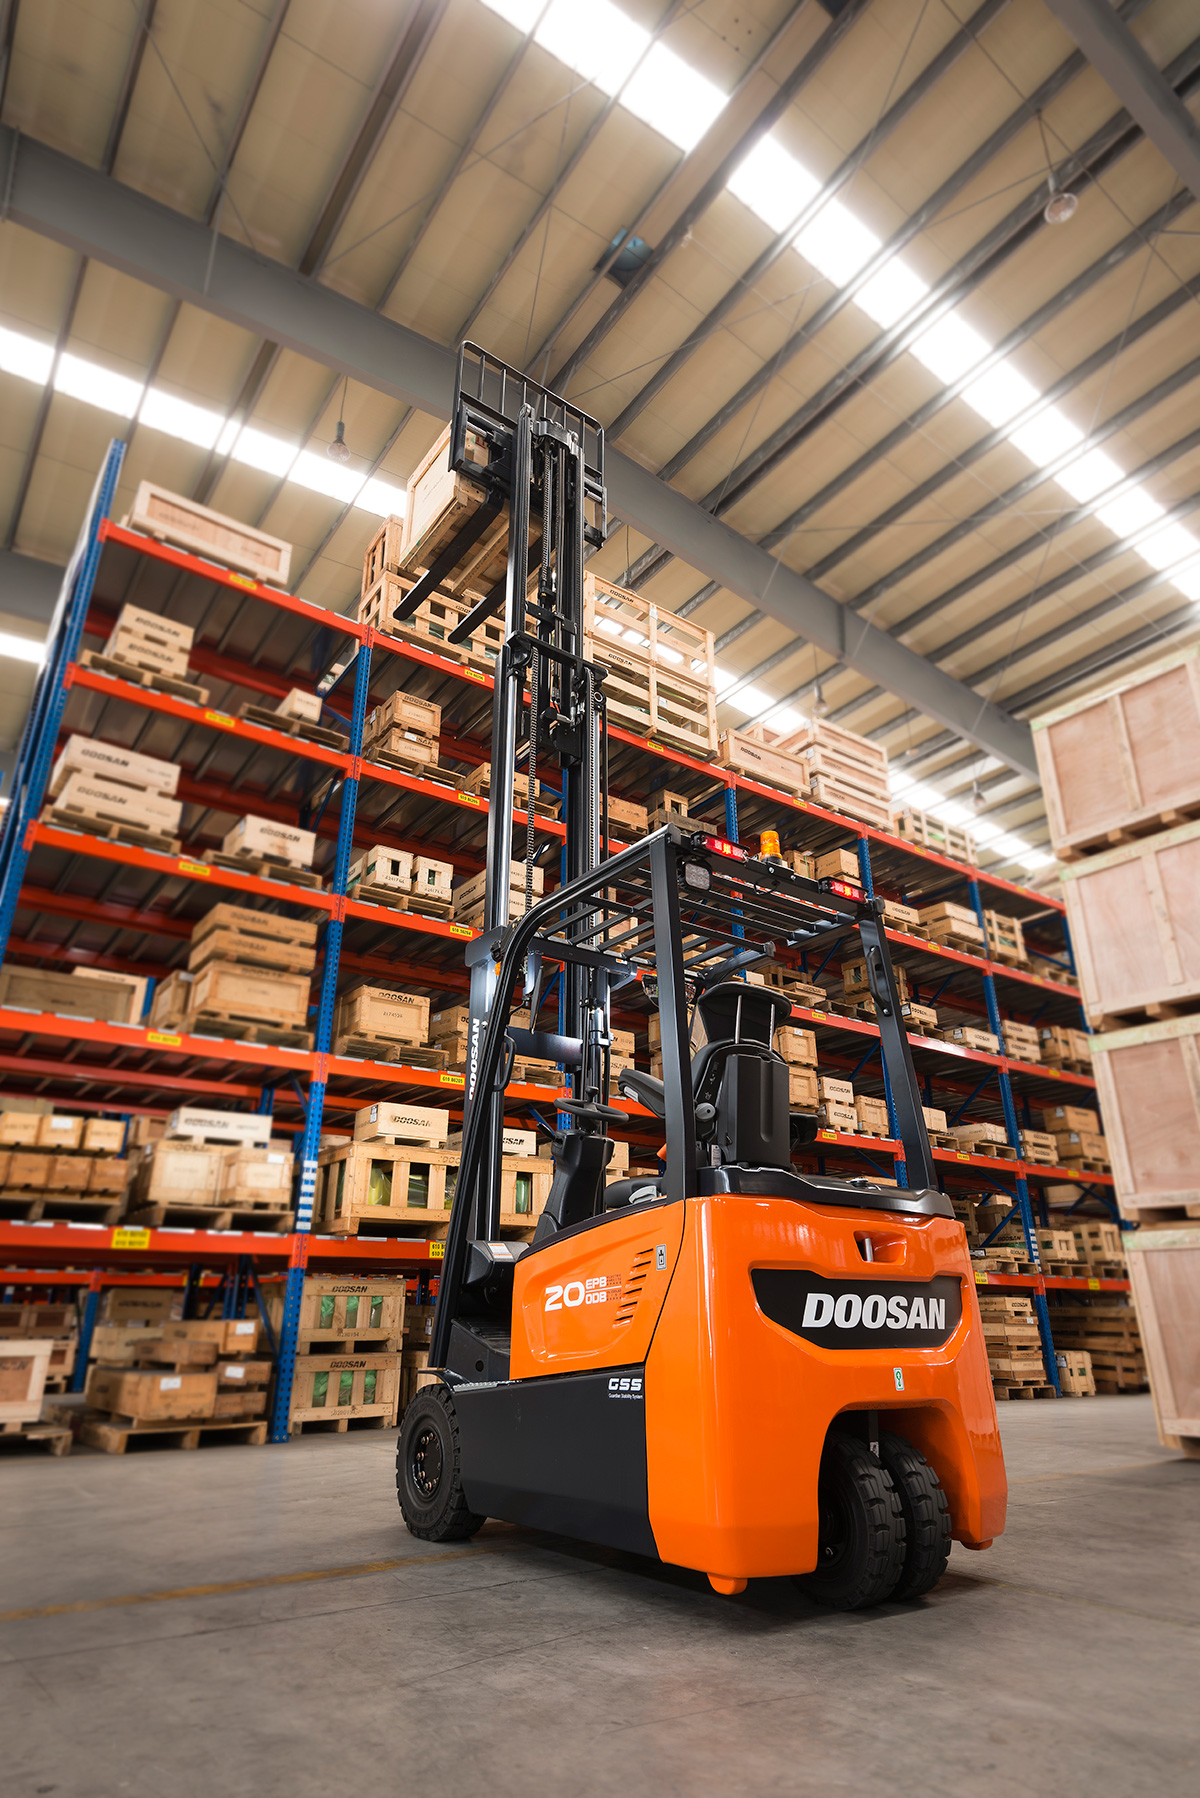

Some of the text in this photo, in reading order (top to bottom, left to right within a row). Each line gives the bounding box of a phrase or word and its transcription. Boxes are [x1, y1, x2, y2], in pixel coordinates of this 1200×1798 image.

[609, 589, 634, 603] DOOSAN
[404, 695, 433, 708] DOOSAN
[416, 737, 434, 747] SAN
[81, 749, 130, 767] DOOSAN
[741, 747, 762, 760] DOOSAN
[259, 827, 301, 843] DOOSAN
[379, 991, 415, 1005] DOOSAN
[392, 1115, 431, 1128] DOOSAN
[585, 1276, 607, 1290] EPB
[545, 1281, 585, 1312] 20
[801, 1293, 946, 1330] DOOSAN
[329, 1360, 367, 1369] DOOSAN
[608, 1378, 642, 1391] GSS
